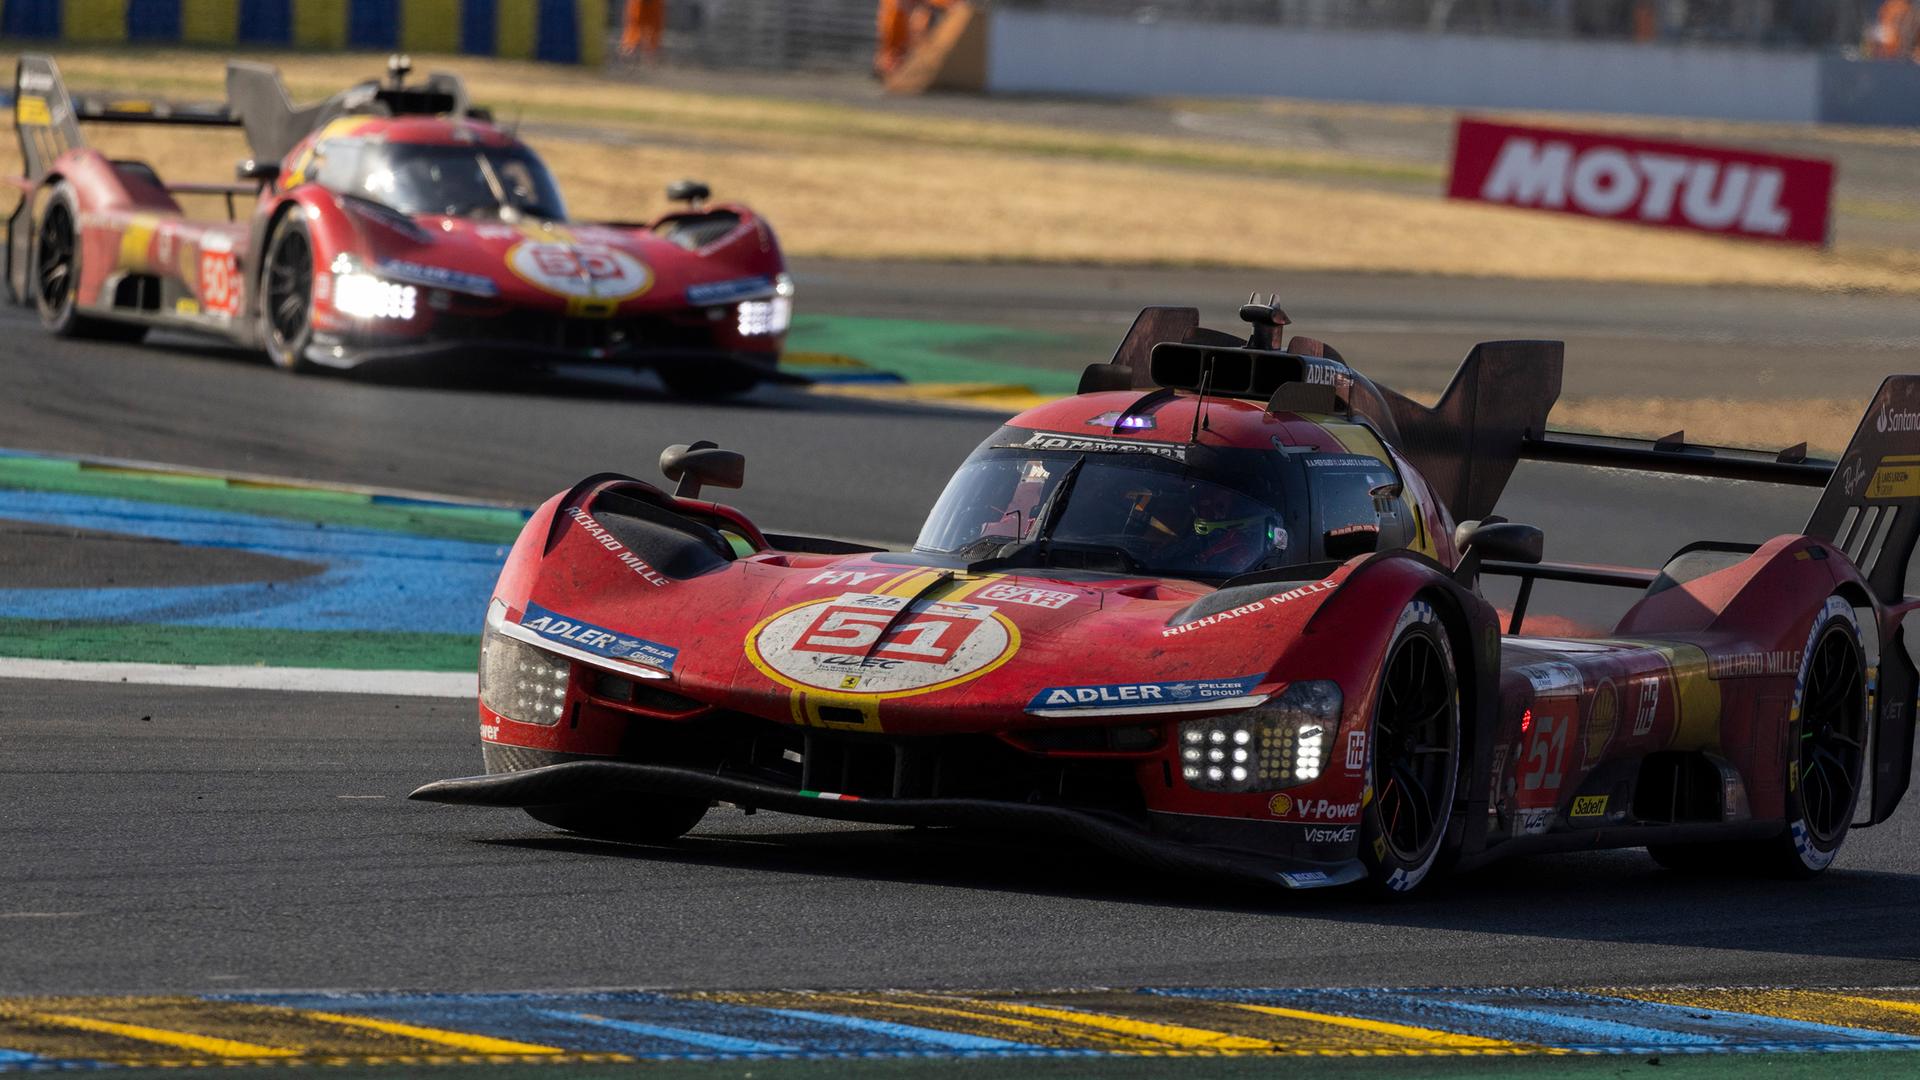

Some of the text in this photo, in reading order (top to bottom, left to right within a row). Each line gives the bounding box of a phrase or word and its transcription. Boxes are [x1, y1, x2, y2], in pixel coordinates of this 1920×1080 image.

[1482, 137, 1791, 235] MOTUL
[537, 250, 617, 278] 50
[203, 256, 229, 303] 50
[1306, 363, 1336, 386] ADLER
[563, 506, 670, 587] RICHARD MILLE
[807, 571, 887, 585] HY
[985, 590, 1060, 606] CAR
[1162, 579, 1338, 637] RICHARD MILLE
[520, 616, 617, 648] ADLER
[806, 611, 953, 656] 51
[630, 651, 664, 664] GROUP
[639, 645, 674, 659] PELZER
[1718, 650, 1801, 676] RICHARD MILLE
[1045, 685, 1163, 705] ADLER
[1198, 682, 1242, 690] PELZER
[1200, 689, 1244, 697] GROUP
[1524, 716, 1568, 790] 51
[1296, 798, 1361, 819] V-Power
[1575, 797, 1604, 815] Sabelt
